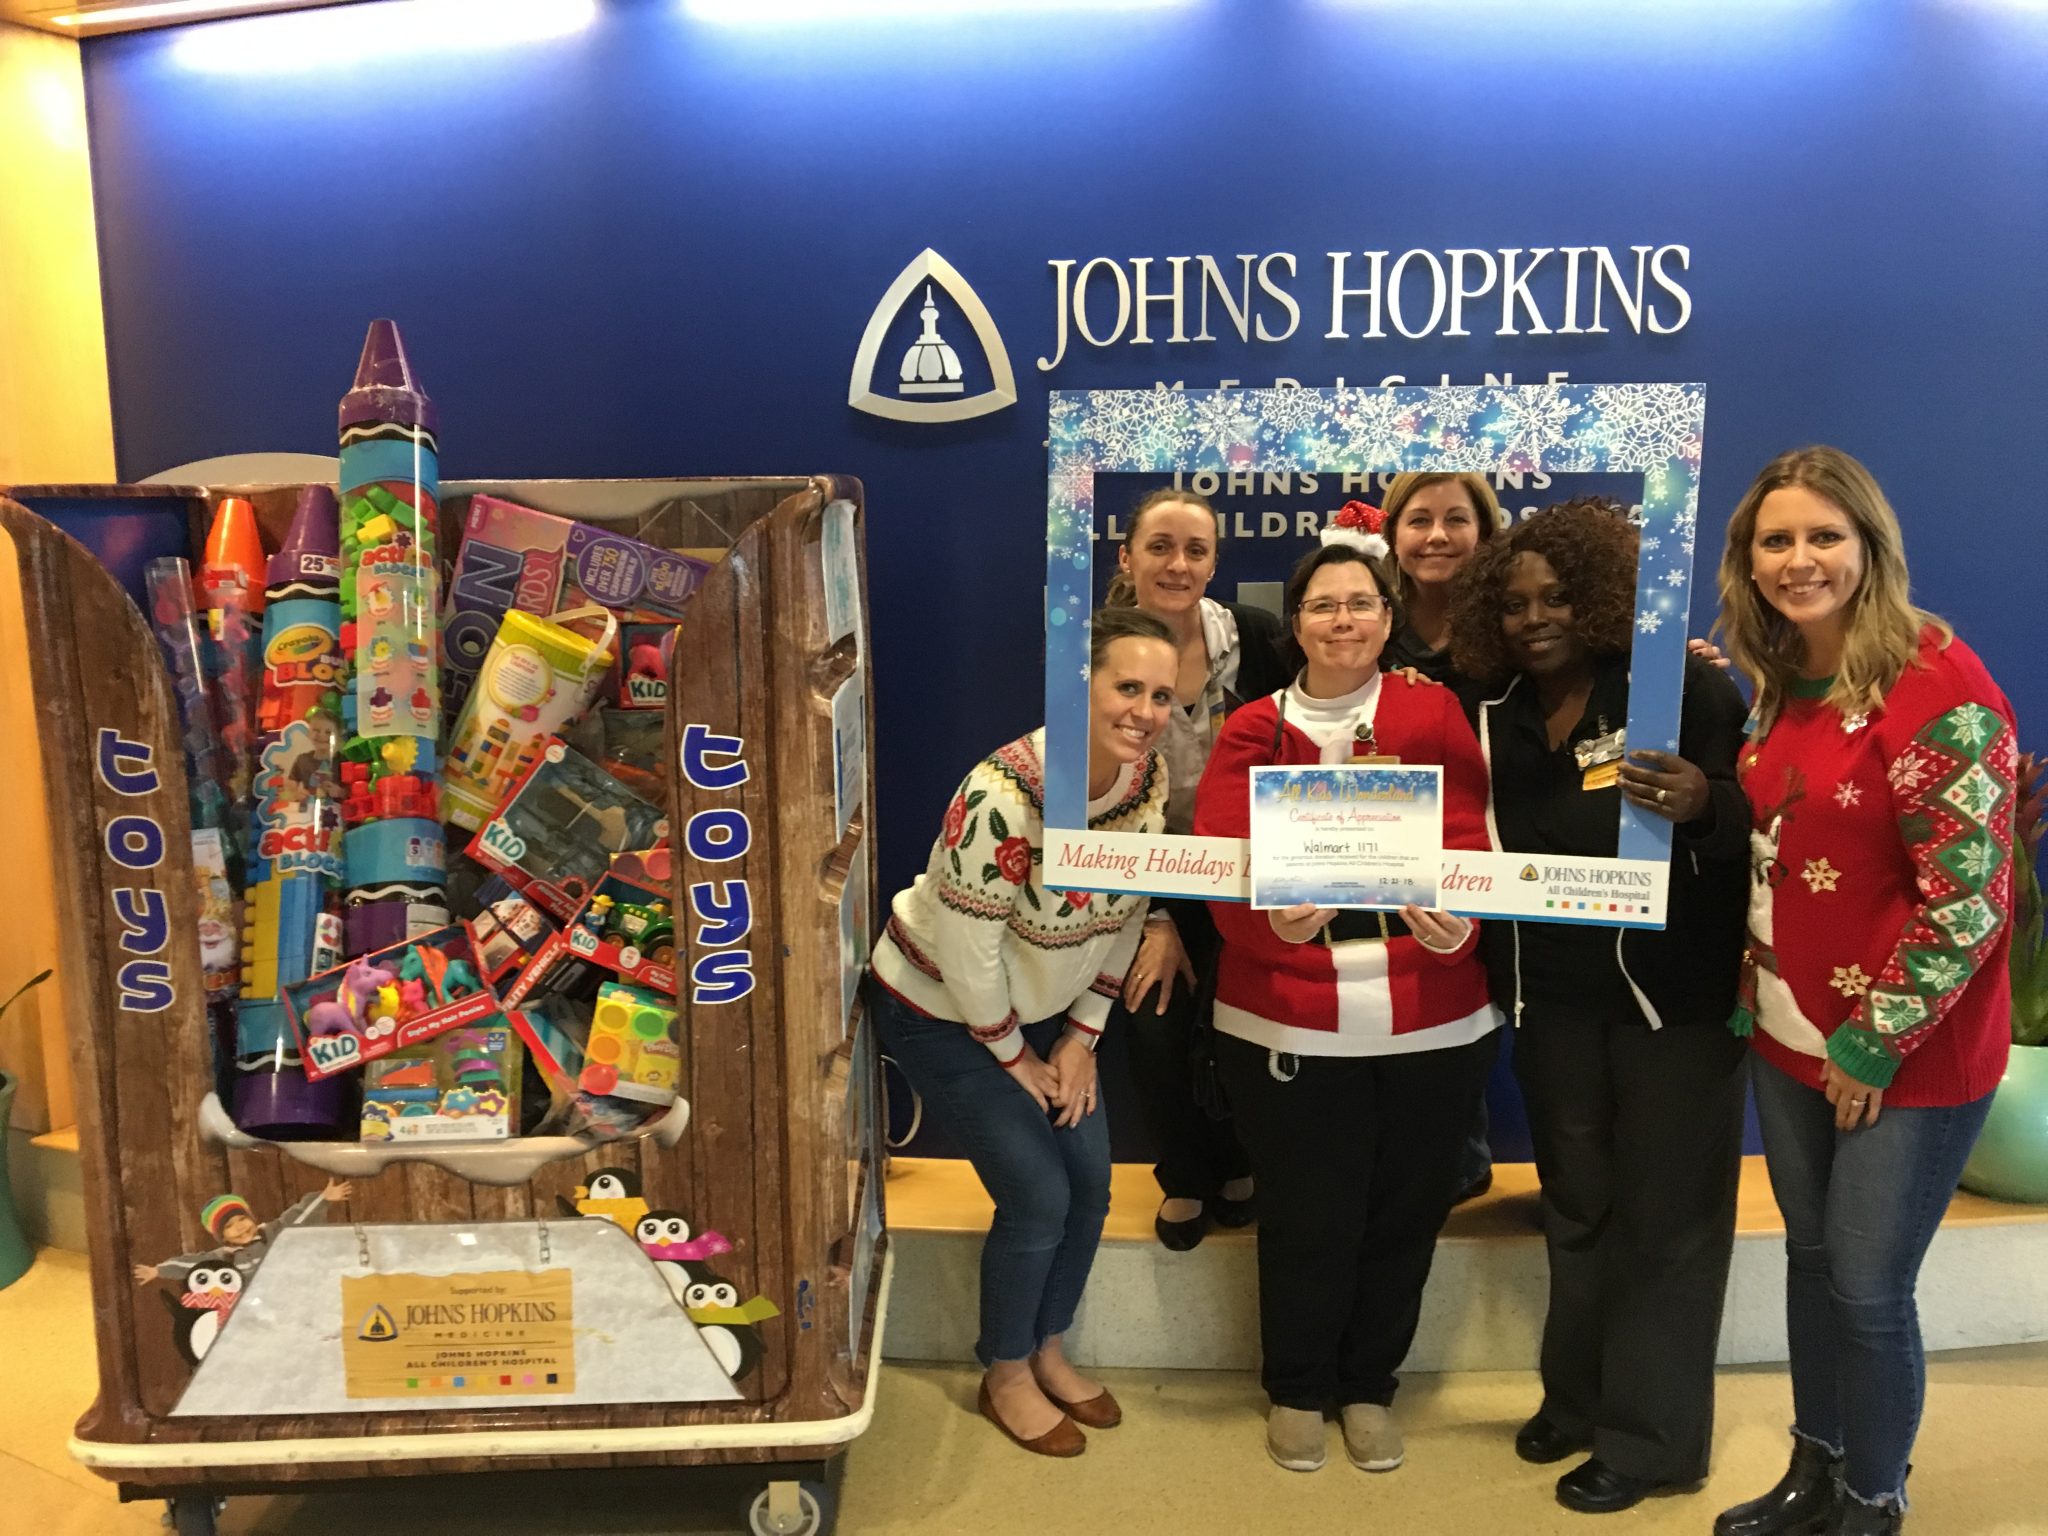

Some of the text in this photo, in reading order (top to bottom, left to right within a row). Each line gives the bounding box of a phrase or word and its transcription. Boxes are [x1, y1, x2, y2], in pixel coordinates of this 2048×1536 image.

[1037, 244, 1692, 372] JOHNS HOPKINS
[303, 556, 324, 571] 25
[584, 544, 605, 586] INCLUDES
[596, 547, 619, 593] OVER 750
[630, 681, 667, 698] KID
[484, 823, 522, 858] KID
[1304, 839, 1378, 853] Walmart 1171
[1057, 843, 1139, 880] Making
[1144, 847, 1235, 885] Holidays
[1541, 866, 1653, 887] JOHNS HOPKINS
[1547, 886, 1650, 901] All Children's Hospital
[571, 931, 598, 950] KID
[311, 1036, 357, 1066] KID
[451, 1286, 493, 1296] Supported
[403, 1301, 556, 1331] JOHNS HOPKINS
[434, 1330, 526, 1338] MEDICINE
[431, 1359, 498, 1368] CHILDREN'S
[502, 1358, 557, 1366] HOSPITAL
[436, 1350, 527, 1360] JOHNS HOPKINS
